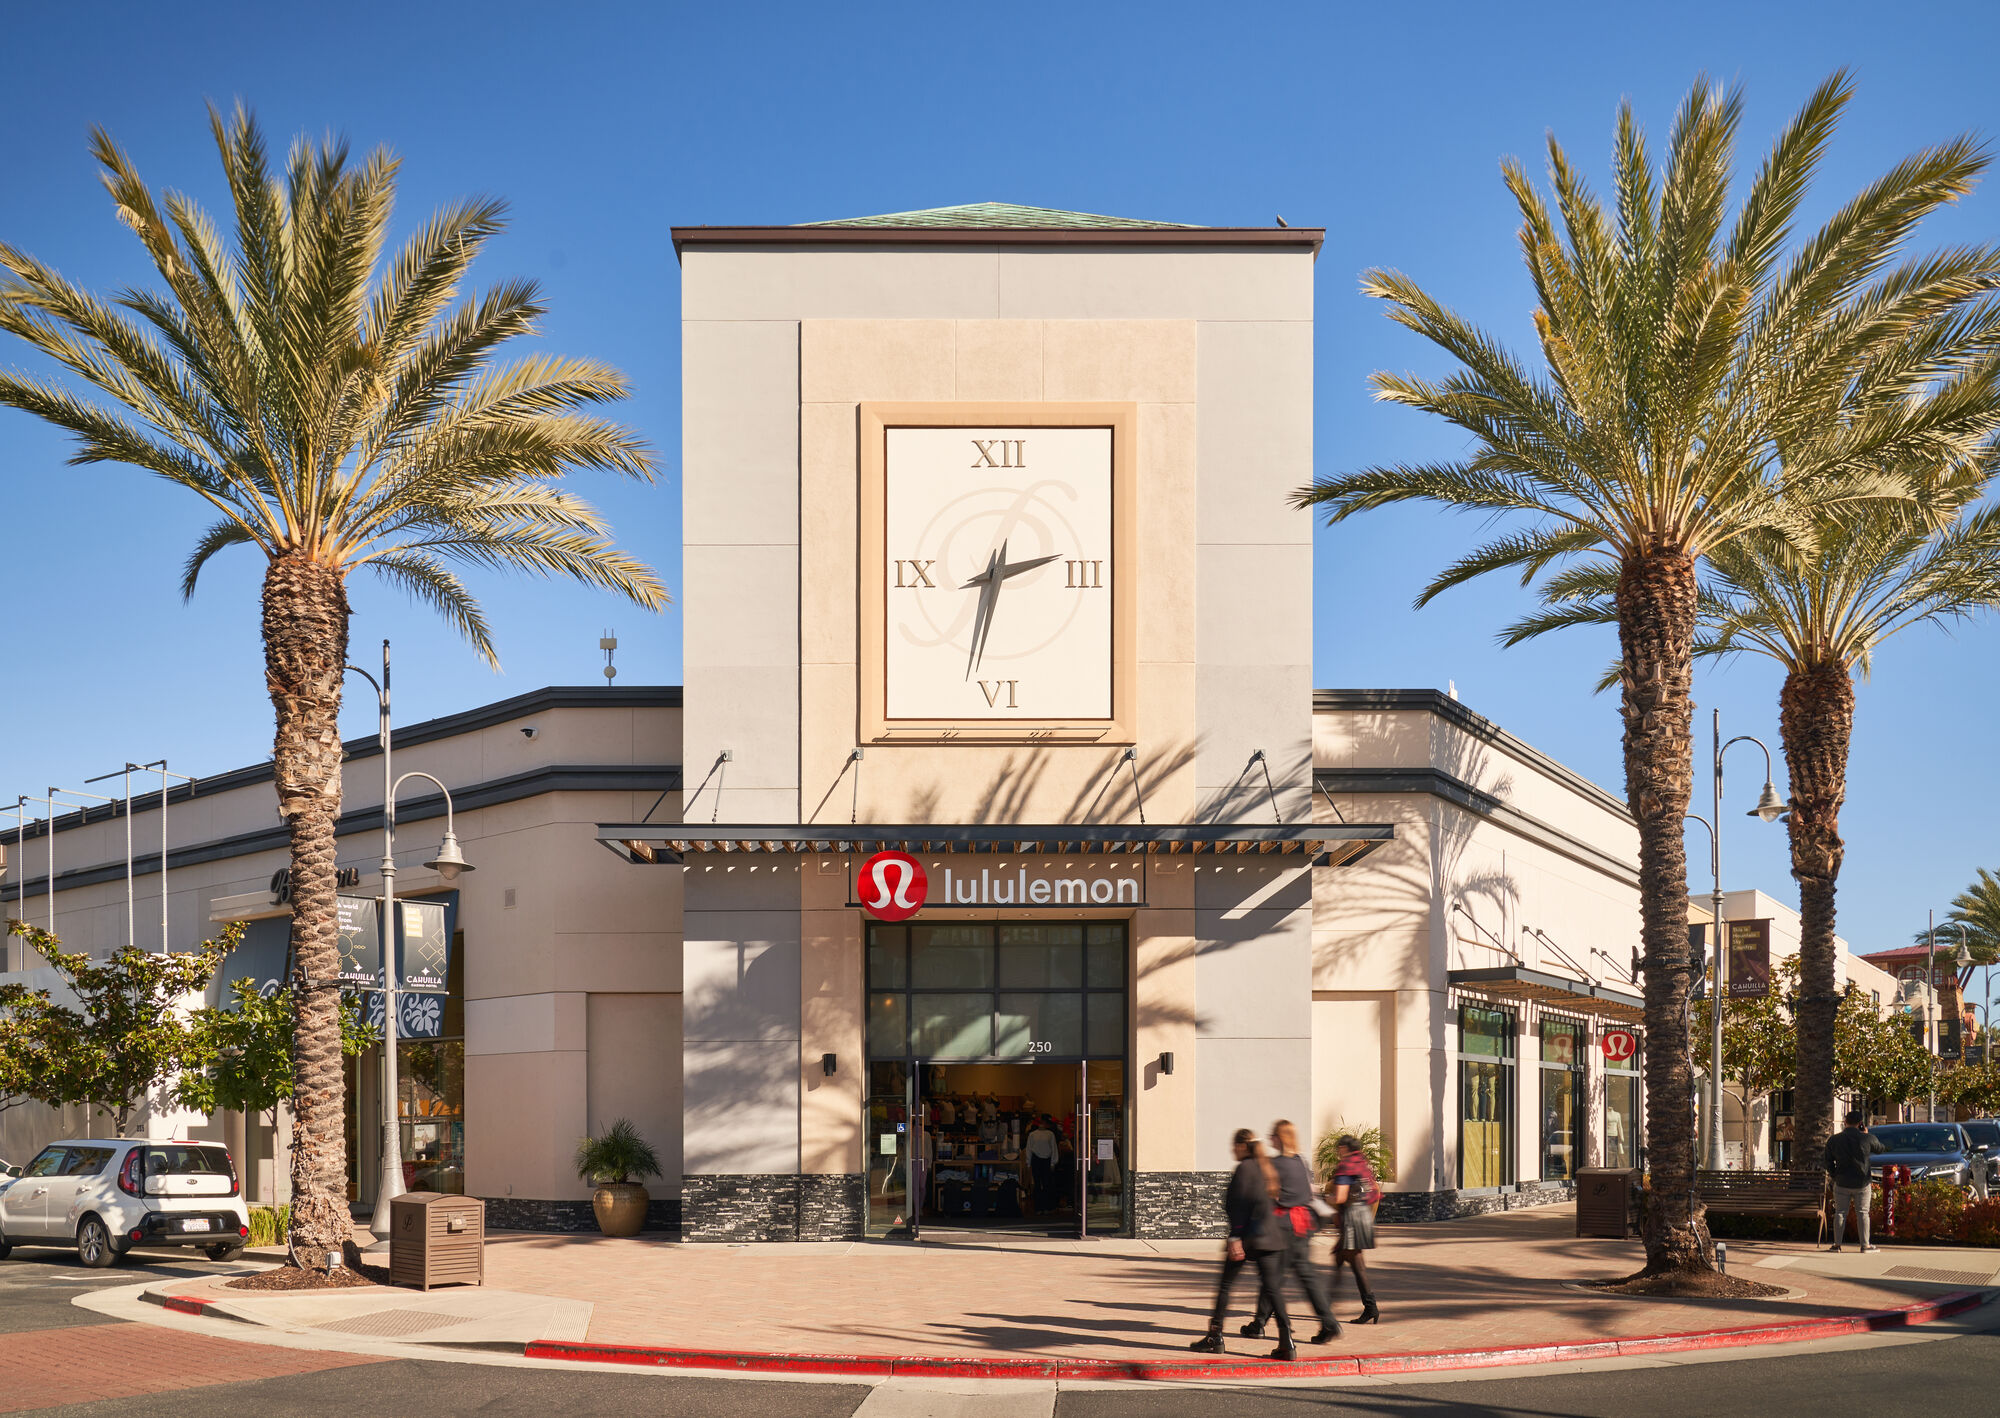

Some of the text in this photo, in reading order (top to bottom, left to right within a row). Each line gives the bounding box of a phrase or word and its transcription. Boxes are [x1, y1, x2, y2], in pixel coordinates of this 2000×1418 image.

[971, 439, 1026, 468] XII
[894, 560, 936, 588] IX
[1064, 560, 1103, 588] III
[976, 680, 1019, 708] VI
[944, 868, 1139, 905] lululemon
[338, 971, 376, 981] CAHUILLA
[406, 975, 442, 985] CAHUILLA
[1732, 982, 1766, 990] CAHUILLA
[1027, 1040, 1053, 1053] 250
